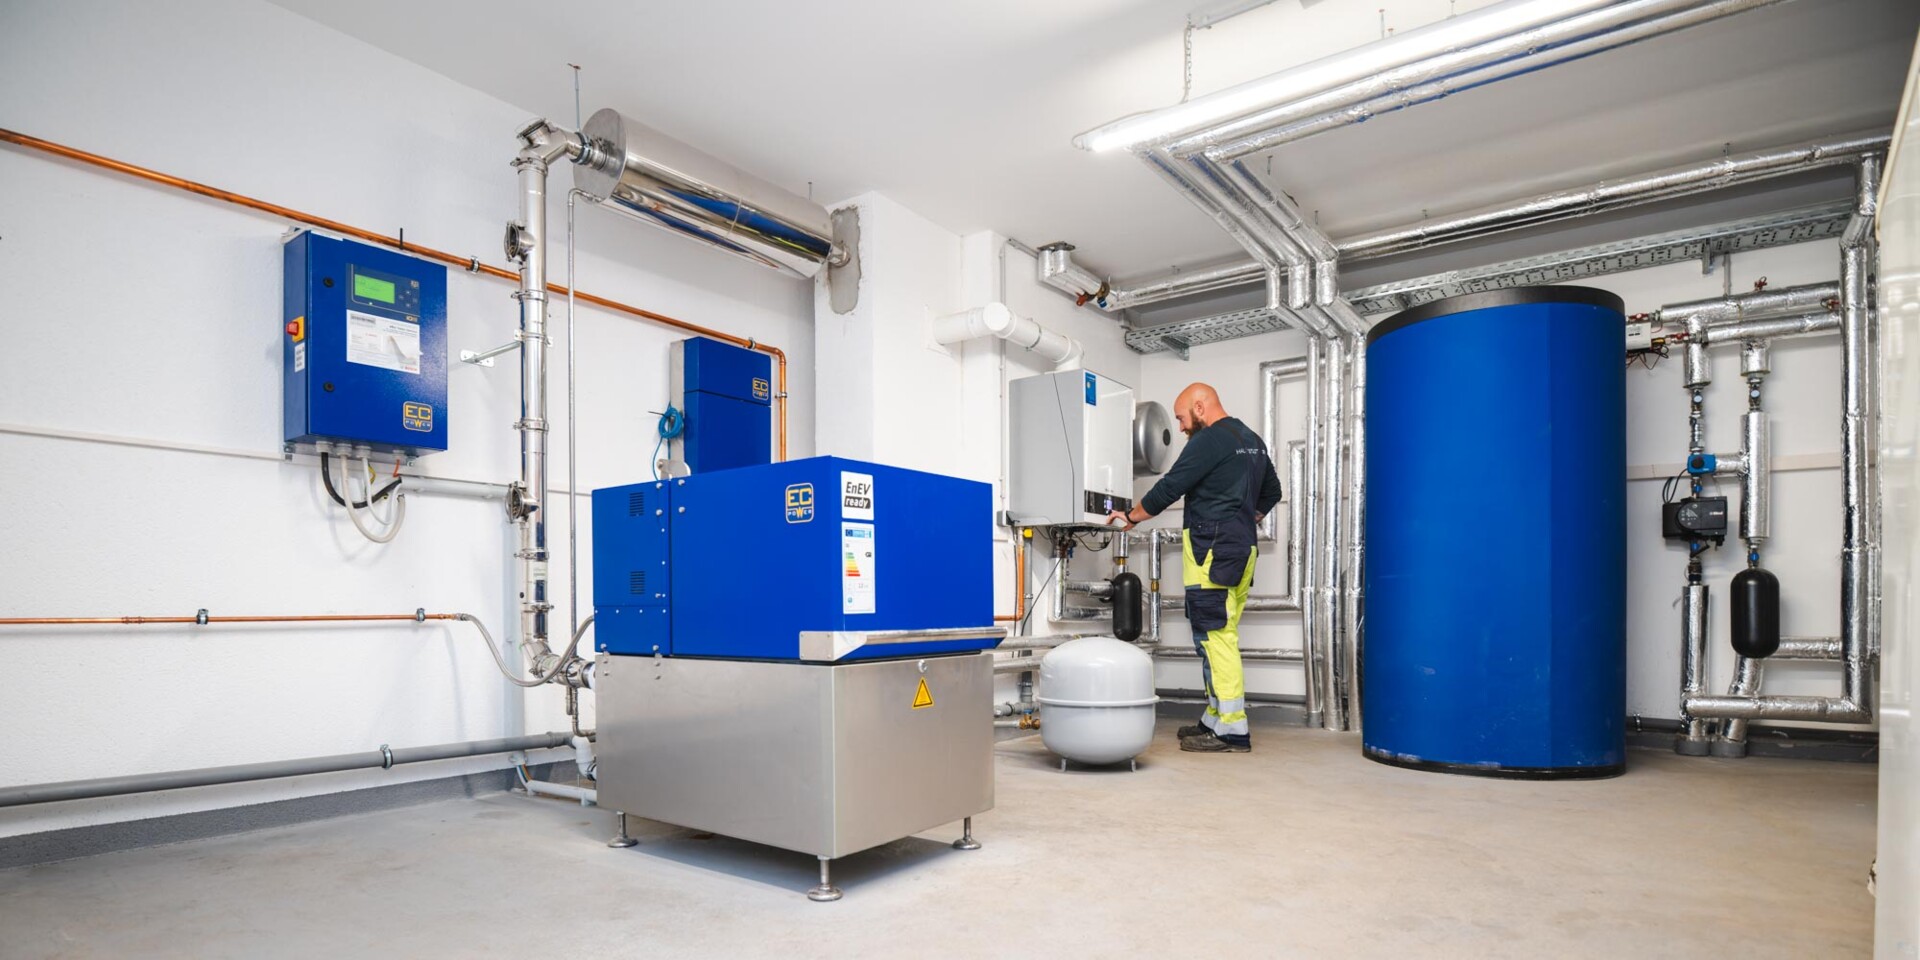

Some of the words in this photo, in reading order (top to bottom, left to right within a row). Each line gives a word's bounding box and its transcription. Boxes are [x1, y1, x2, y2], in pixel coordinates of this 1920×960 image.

[405, 405, 431, 420] EC
[846, 481, 871, 496] EnEV
[787, 487, 812, 506] EC
[845, 497, 869, 509] ready
